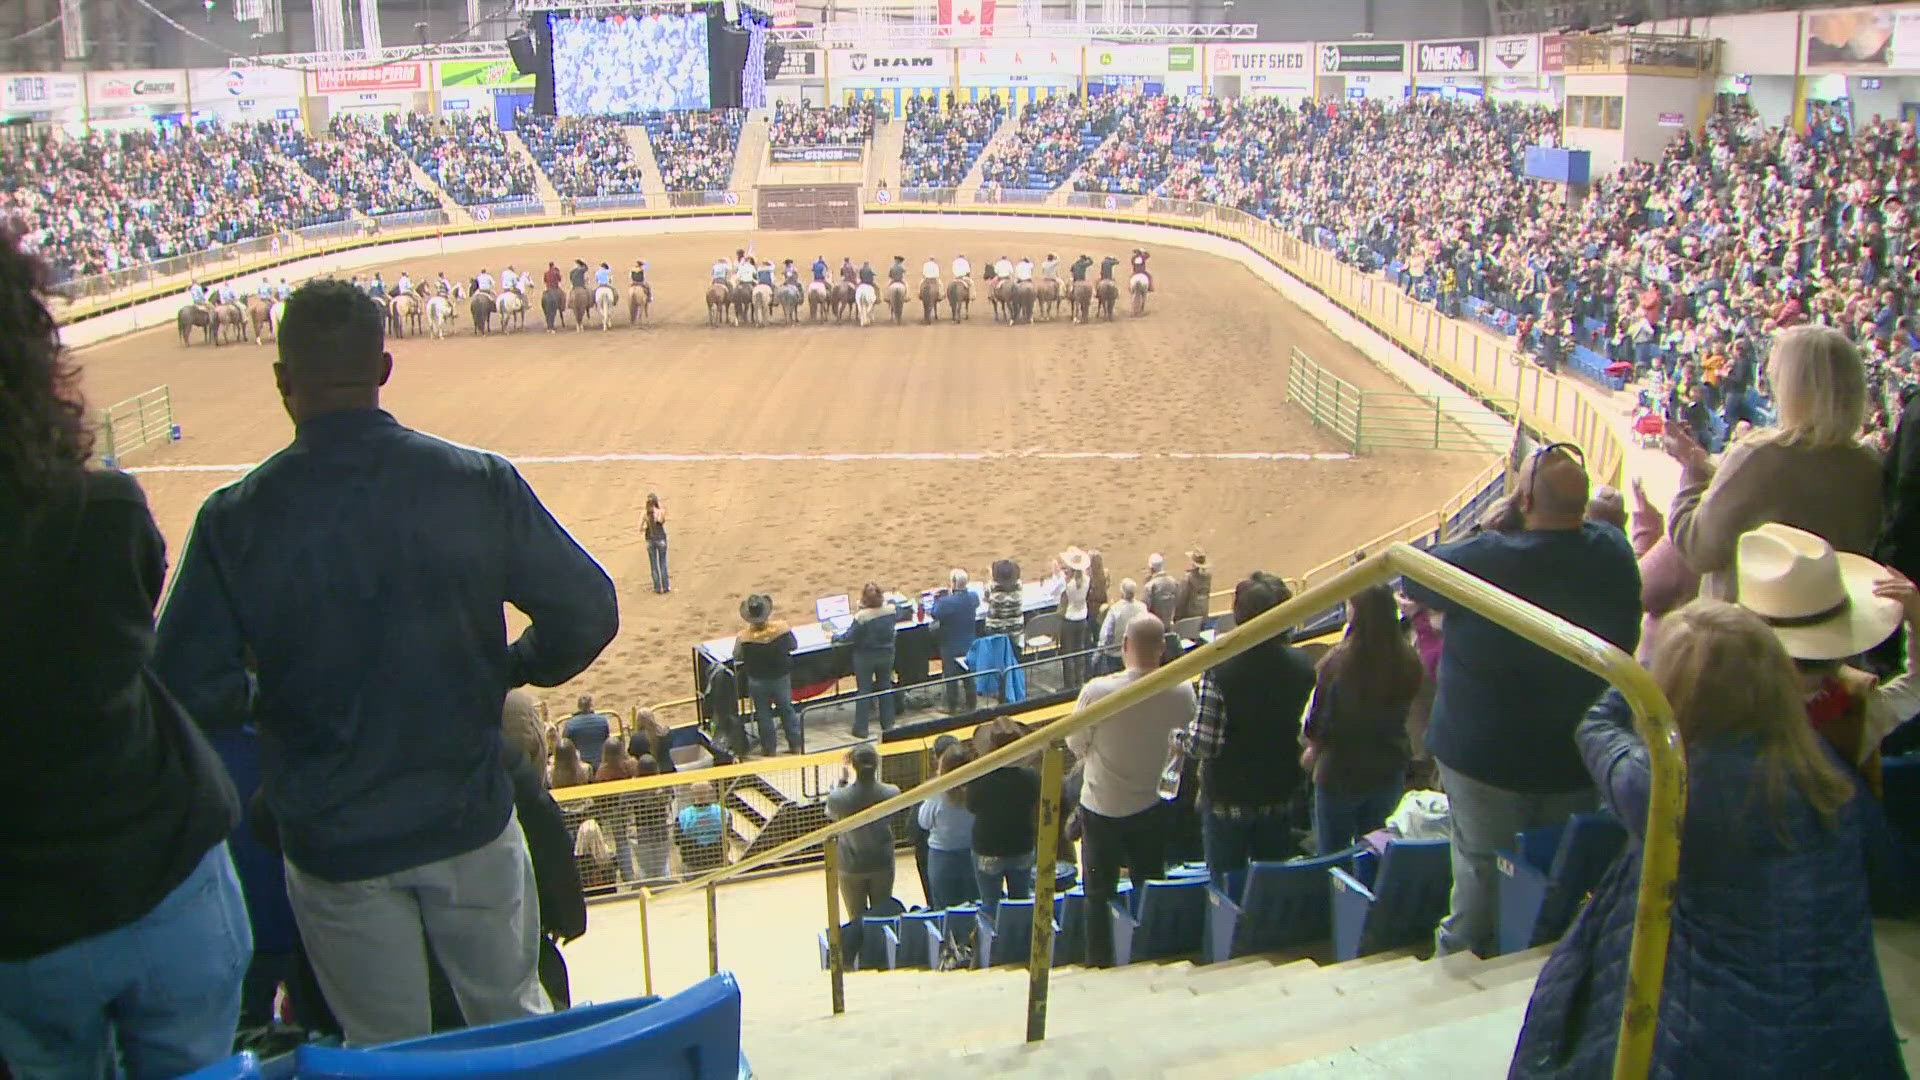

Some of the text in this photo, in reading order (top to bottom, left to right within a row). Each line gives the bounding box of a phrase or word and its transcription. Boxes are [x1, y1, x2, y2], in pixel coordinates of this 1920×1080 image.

[873, 57, 933, 67] RAM
[1232, 53, 1303, 69] TUFF SHED
[1421, 45, 1463, 70] 9NEWS
